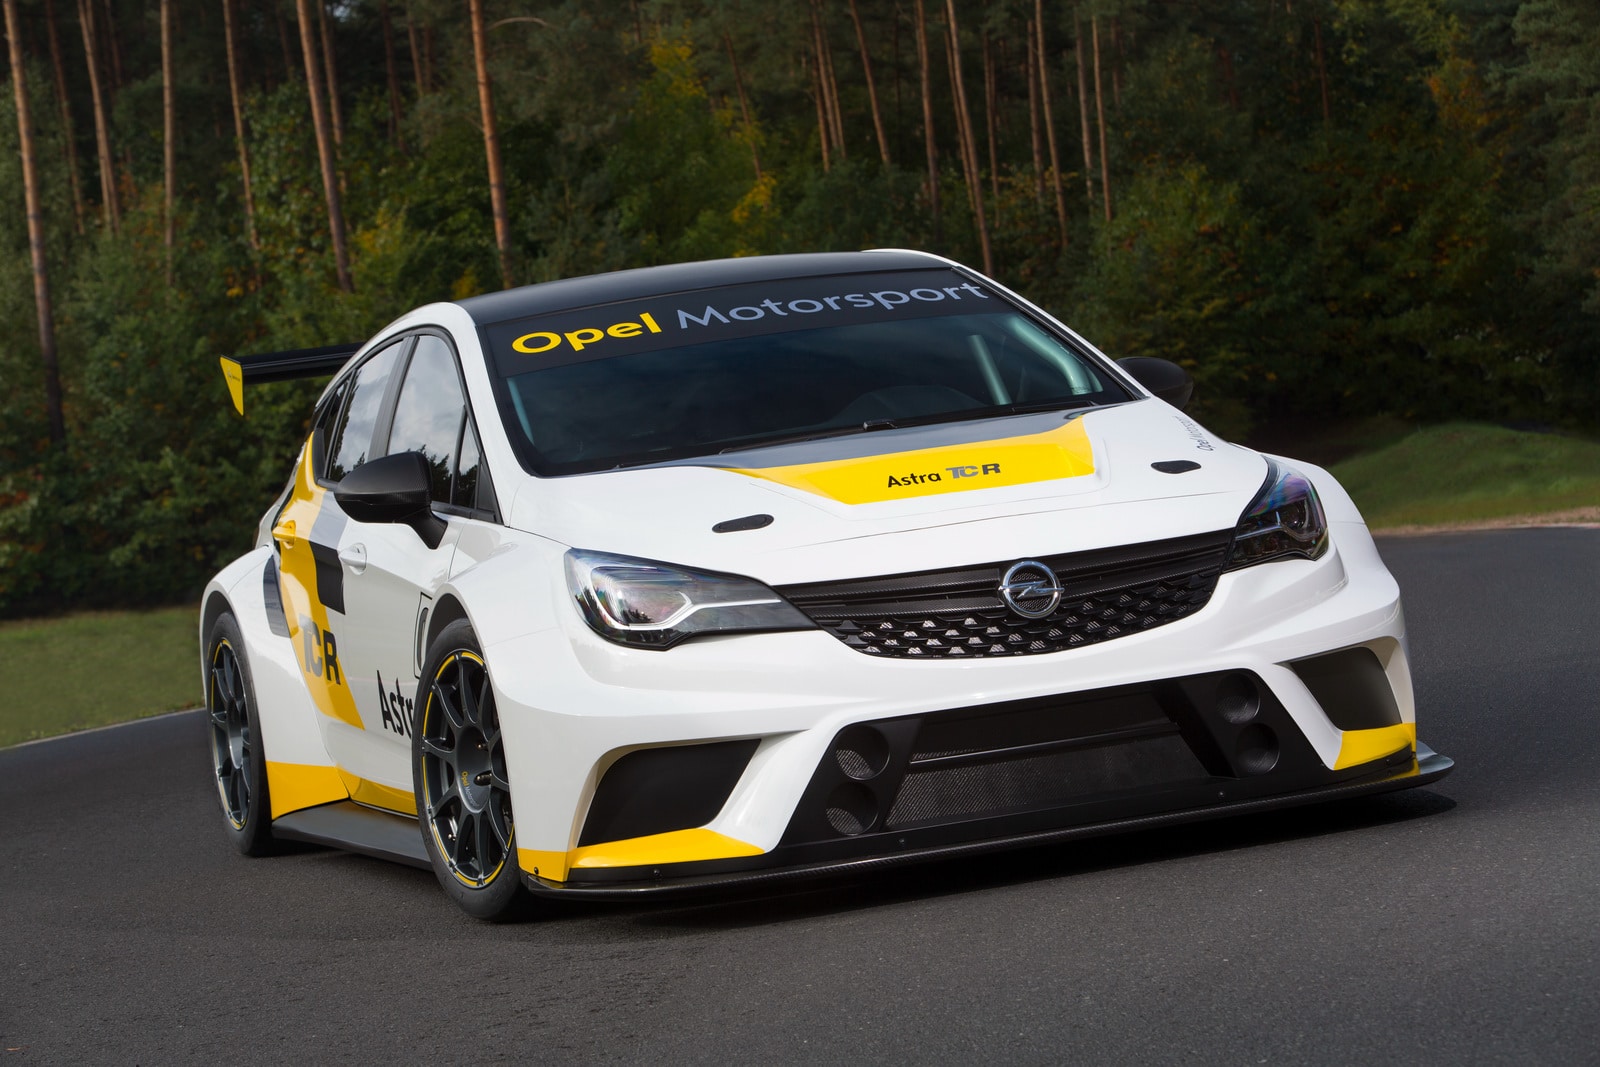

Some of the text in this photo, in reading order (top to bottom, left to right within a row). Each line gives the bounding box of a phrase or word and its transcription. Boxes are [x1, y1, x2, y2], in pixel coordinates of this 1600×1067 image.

[512, 282, 989, 354] Opel Motorsport
[887, 472, 942, 488] Astra
[377, 670, 413, 739] Astr
